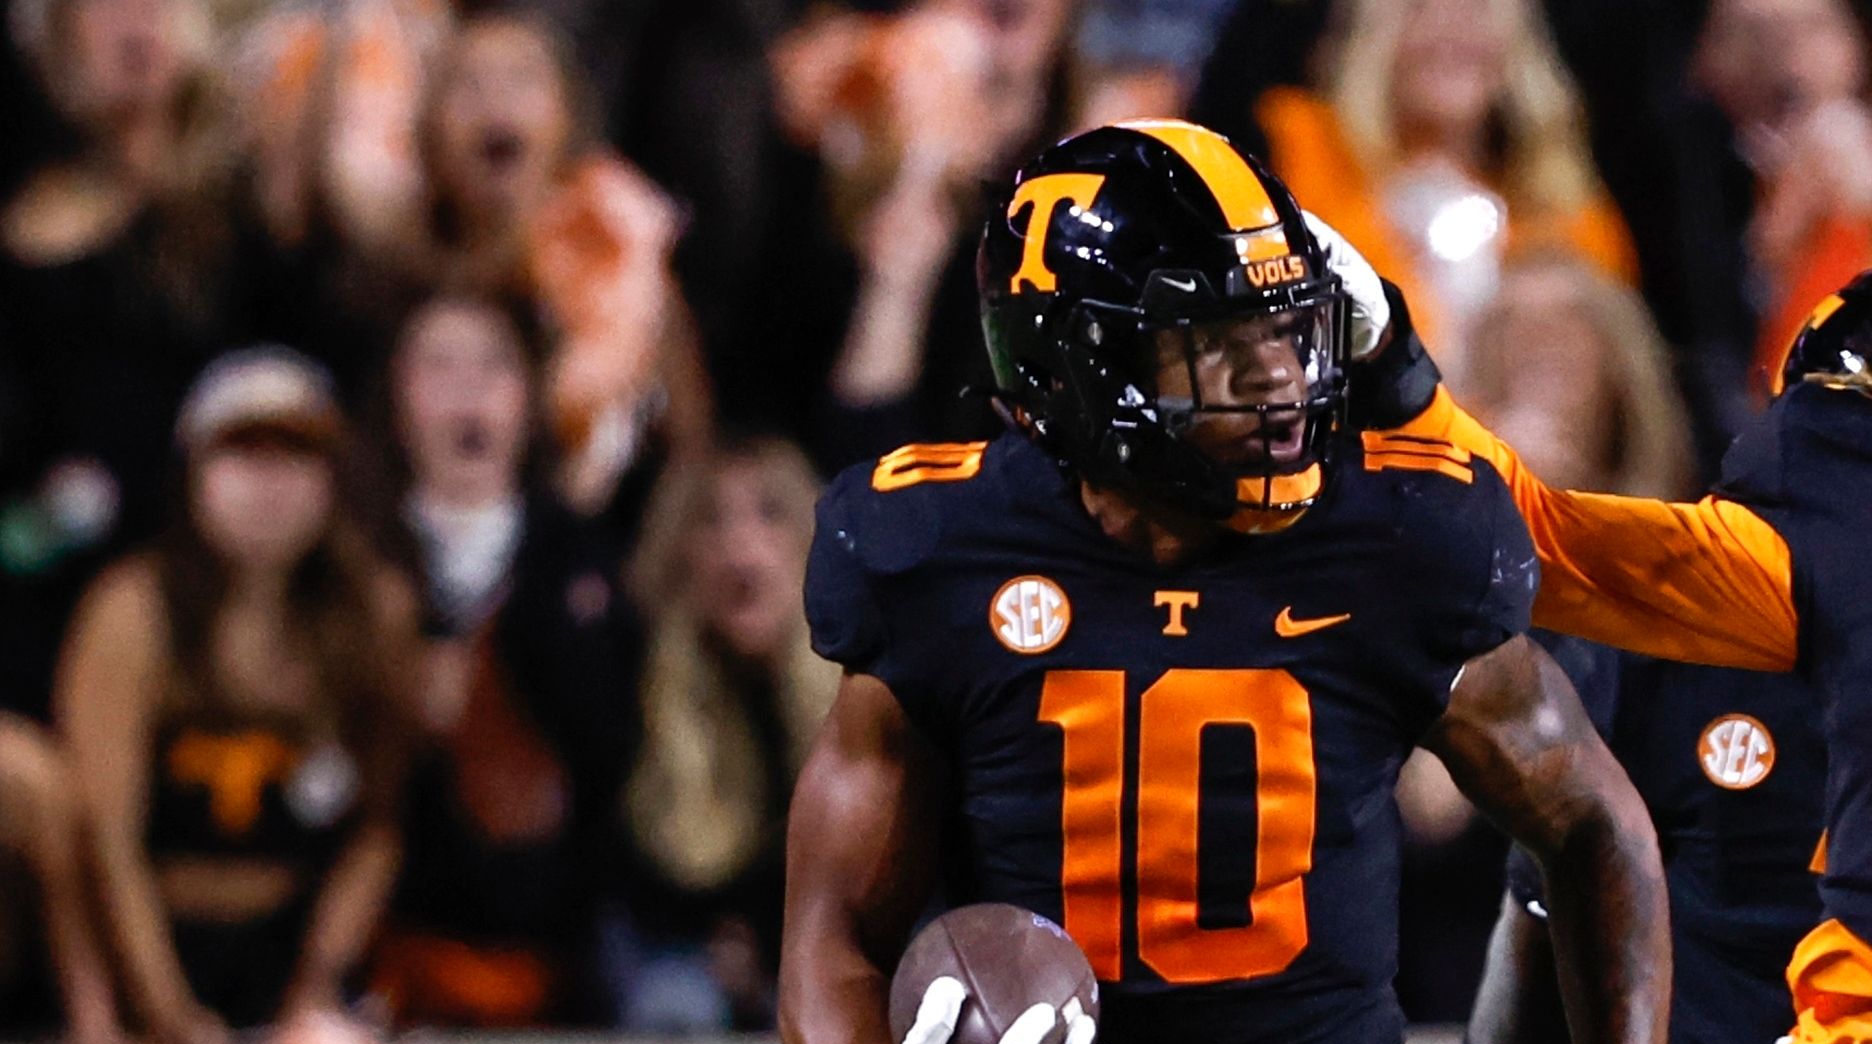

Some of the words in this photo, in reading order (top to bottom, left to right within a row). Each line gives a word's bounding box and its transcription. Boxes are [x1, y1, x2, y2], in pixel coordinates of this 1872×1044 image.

[1008, 173, 1105, 294] T
[1246, 256, 1304, 287] VOLS
[996, 579, 1064, 649] SEC
[1155, 591, 1199, 636] T
[1702, 717, 1771, 787] SEC
[1038, 668, 1316, 984] 10
